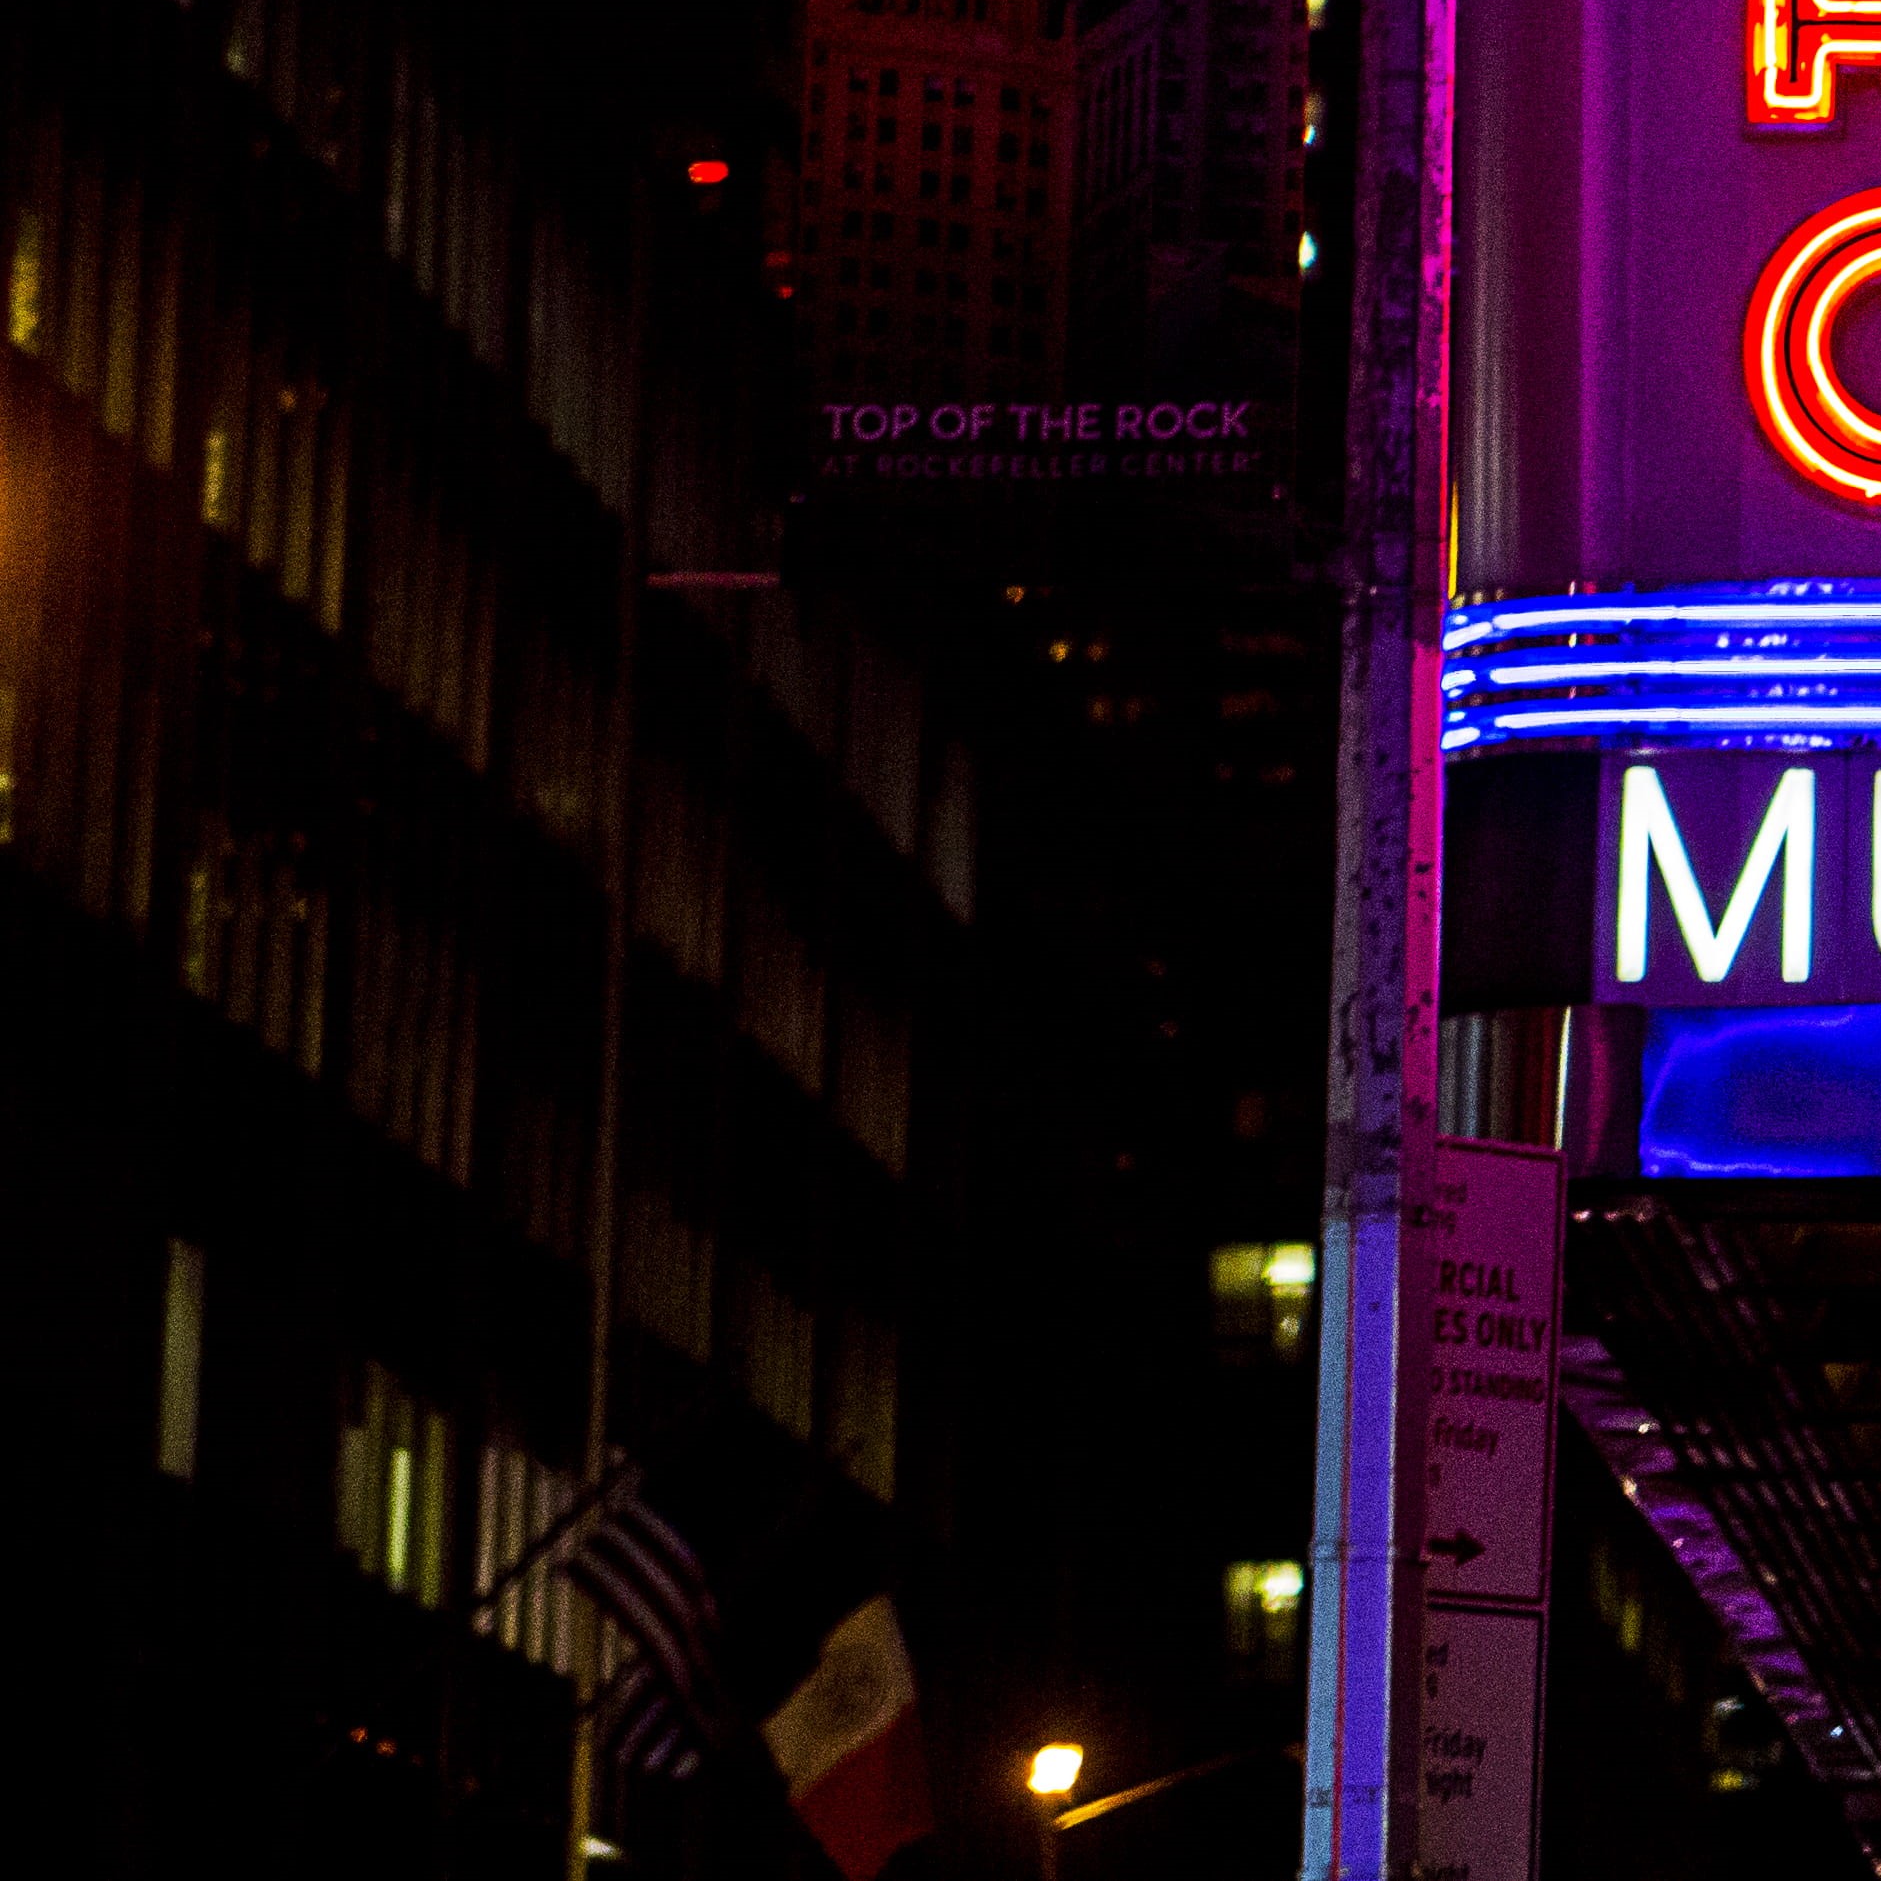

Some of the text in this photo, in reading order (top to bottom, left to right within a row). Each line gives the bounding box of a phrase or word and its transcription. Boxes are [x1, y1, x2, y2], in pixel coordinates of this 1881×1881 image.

[820, 399, 1252, 443] TOP OF THE ROCK
[819, 453, 859, 480] AT
[875, 453, 1109, 480] ROCKEFELLER
[1475, 1311, 1548, 1354] ONLY
